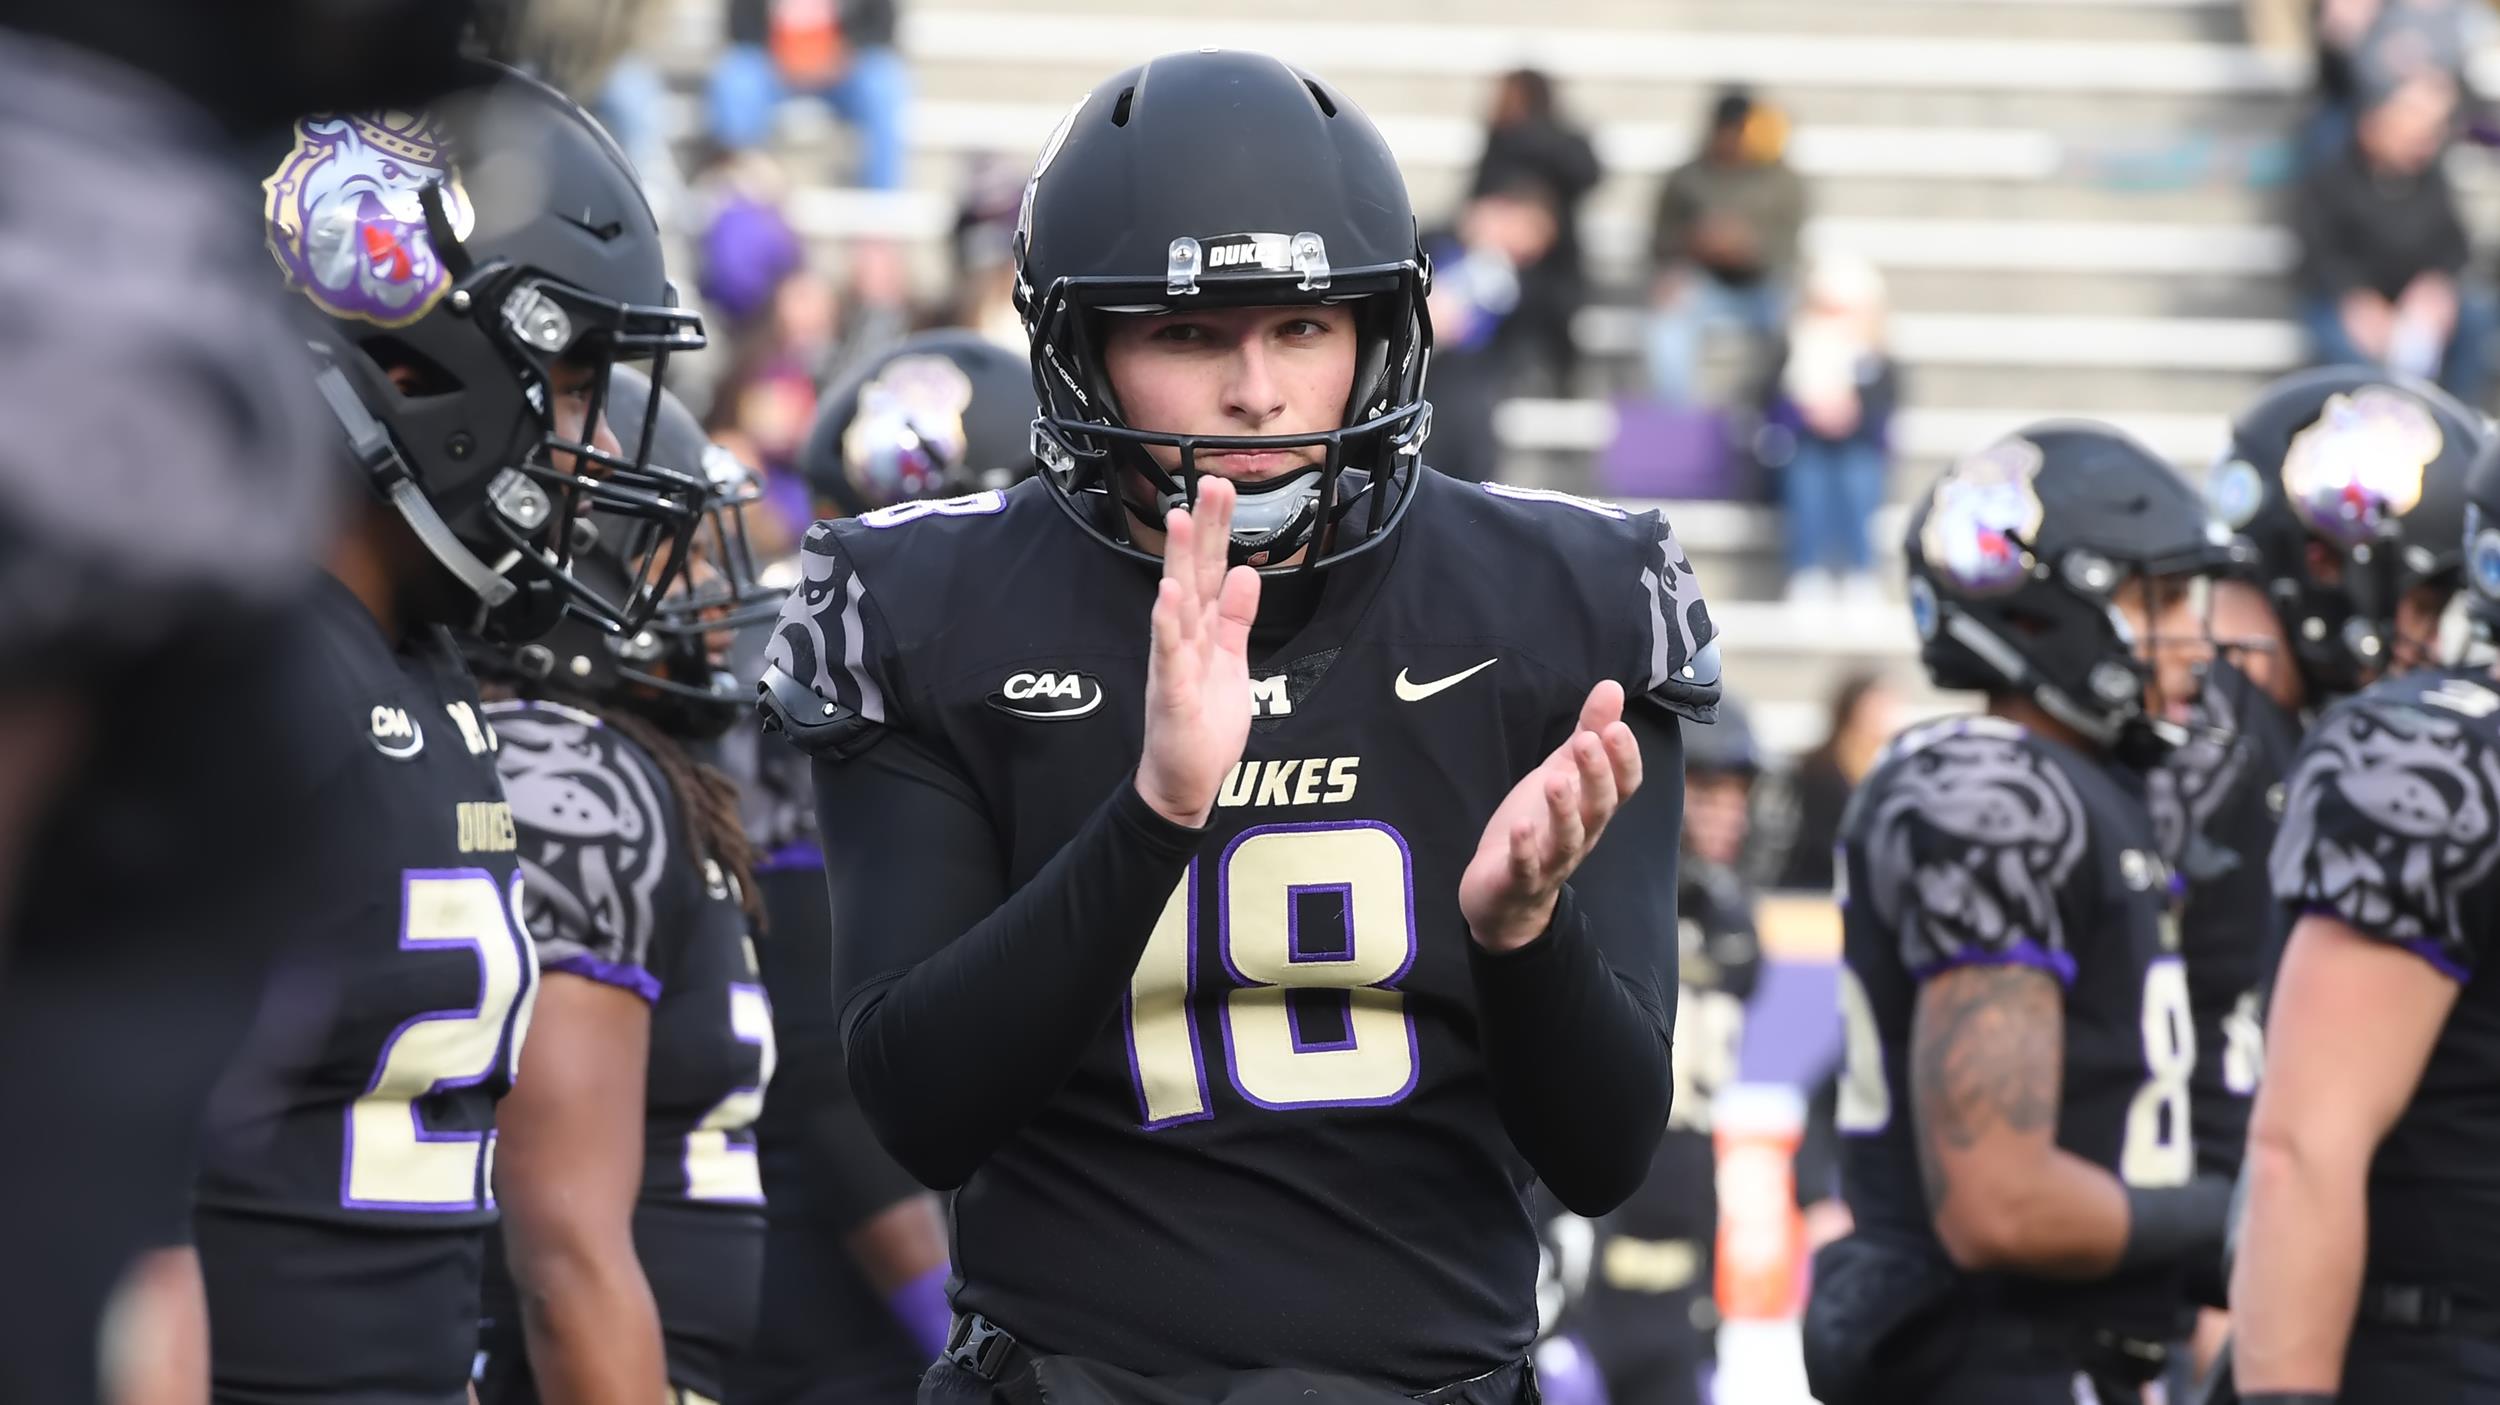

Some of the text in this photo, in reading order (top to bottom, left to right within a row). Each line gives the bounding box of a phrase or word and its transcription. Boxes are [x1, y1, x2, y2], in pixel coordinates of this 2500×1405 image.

[1003, 673, 1081, 700] CAA
[1217, 756, 1361, 807] UKES
[1124, 820, 1420, 1131] 18
